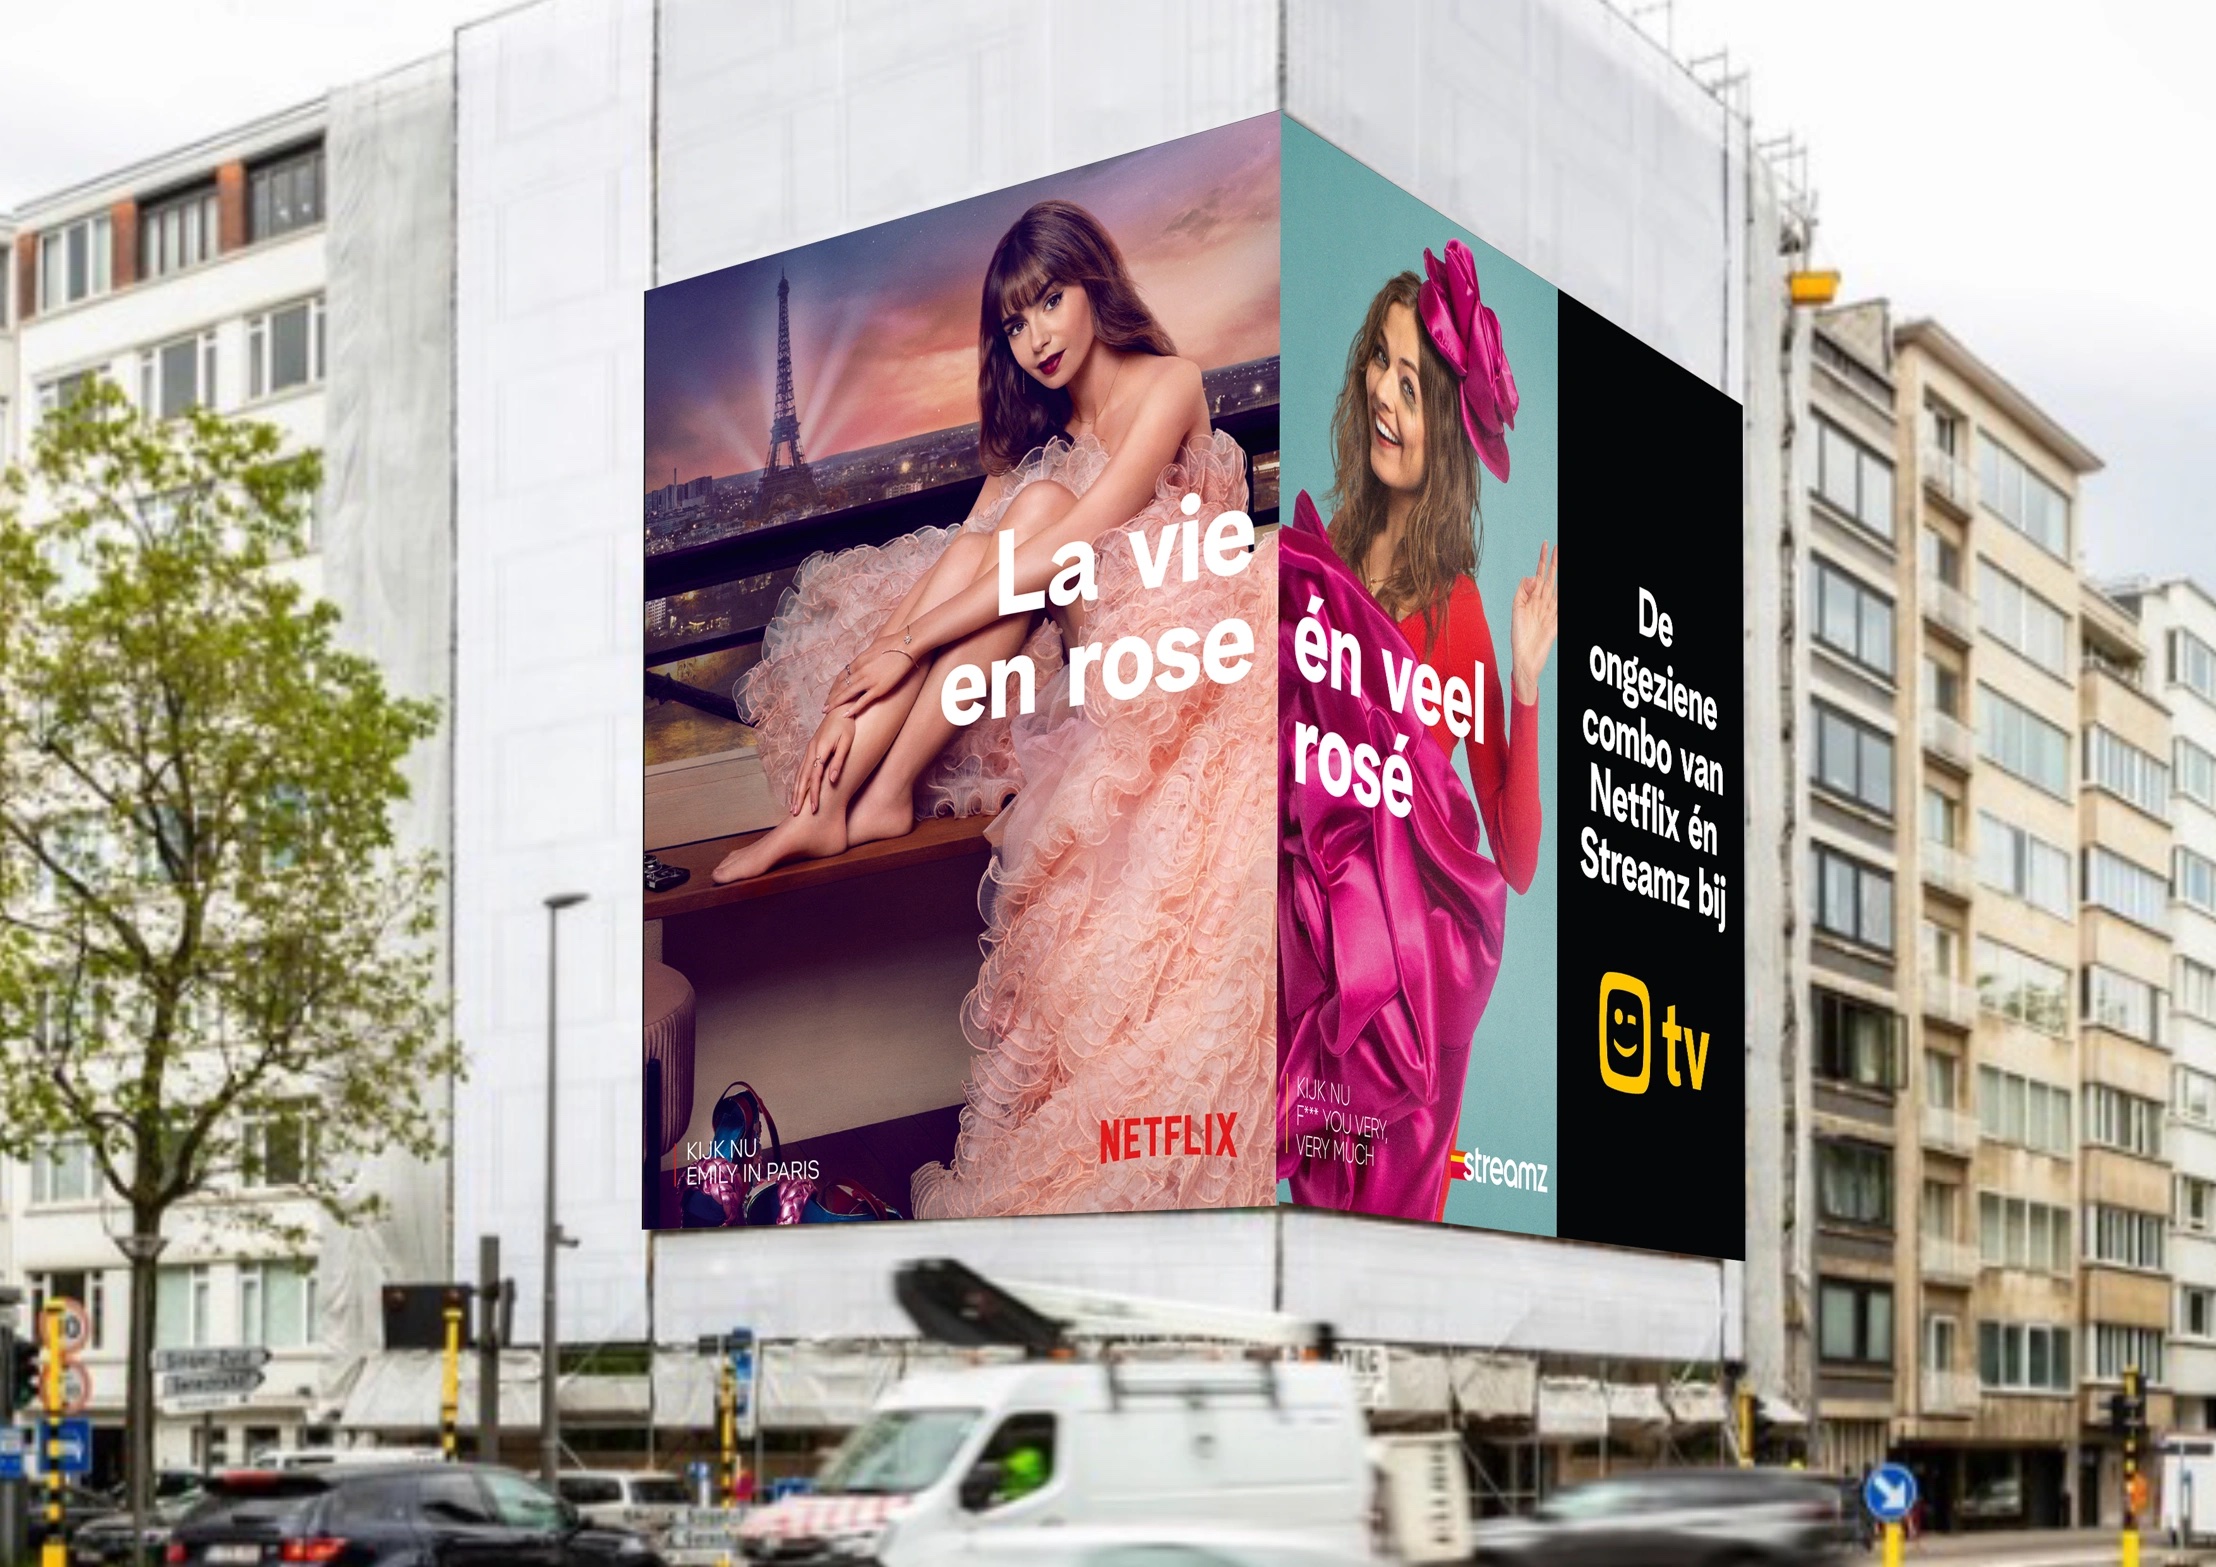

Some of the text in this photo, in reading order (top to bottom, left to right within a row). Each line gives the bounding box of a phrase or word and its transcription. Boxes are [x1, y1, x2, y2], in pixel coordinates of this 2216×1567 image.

[999, 492, 1255, 616] La vie
[1638, 586, 1674, 648] De
[941, 617, 1256, 727] en rose
[1294, 595, 1485, 745] én veel
[1589, 644, 1718, 731] ongeziene
[1295, 720, 1413, 819] rosé
[1582, 708, 1724, 796] combo van
[1590, 762, 1718, 856] Netflix én
[1580, 826, 1727, 934] Streamz bij
[1662, 1004, 1710, 1091] tv
[1296, 1076, 1350, 1107] KIJK NU
[1322, 1109, 1352, 1135] YOU
[1354, 1115, 1388, 1144] VERY,
[687, 1138, 757, 1160] KIJK NU
[687, 1160, 820, 1186] EMILY IN PARIS
[1100, 1111, 1238, 1164] NETFLIX
[1296, 1133, 1375, 1167] VERY MUCH
[1463, 1146, 1548, 1194] streamz
